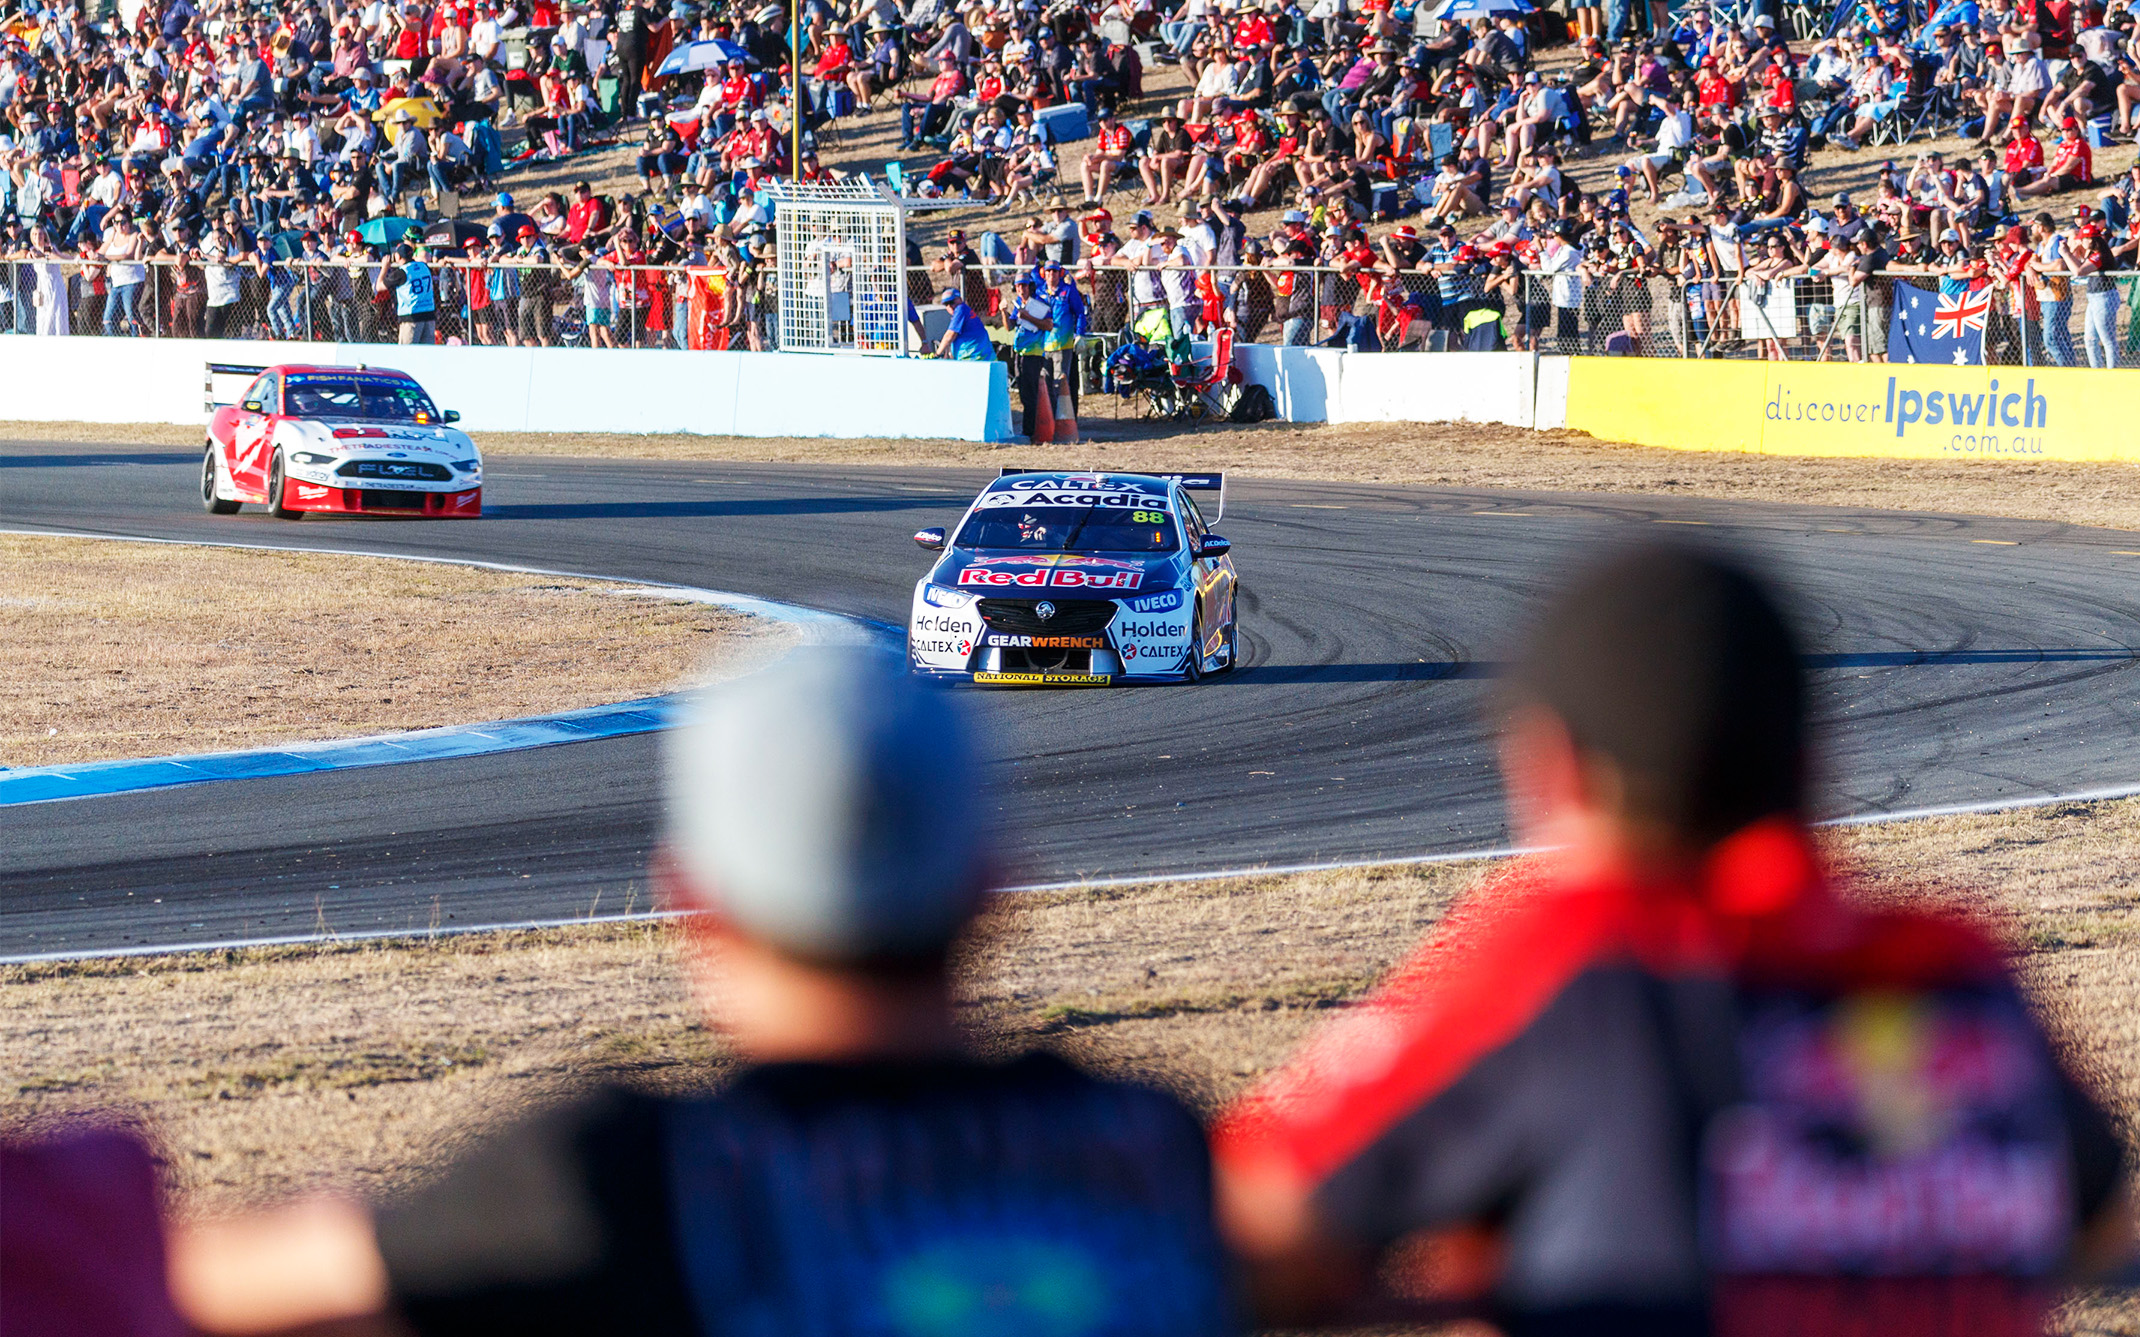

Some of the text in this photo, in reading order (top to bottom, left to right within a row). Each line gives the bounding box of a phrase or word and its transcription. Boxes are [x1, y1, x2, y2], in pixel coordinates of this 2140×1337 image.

[411, 276, 431, 294] 87
[395, 388, 419, 400] 23
[1885, 376, 2047, 437] Ipswich
[1943, 434, 2043, 453] .com.au
[1011, 480, 1146, 493] CALTEX
[1022, 492, 1168, 510] Acadia
[1132, 510, 1165, 524] 88
[959, 569, 1143, 588] Red Bull
[1134, 593, 1177, 612] IVECO
[916, 615, 972, 634] Holden
[1121, 621, 1187, 637] Holden
[916, 640, 954, 653] CALTEX
[988, 635, 1103, 648] GEARWRENCH
[1140, 645, 1184, 658] CALTEX
[976, 672, 1105, 683] NATIONAL STORAGE
